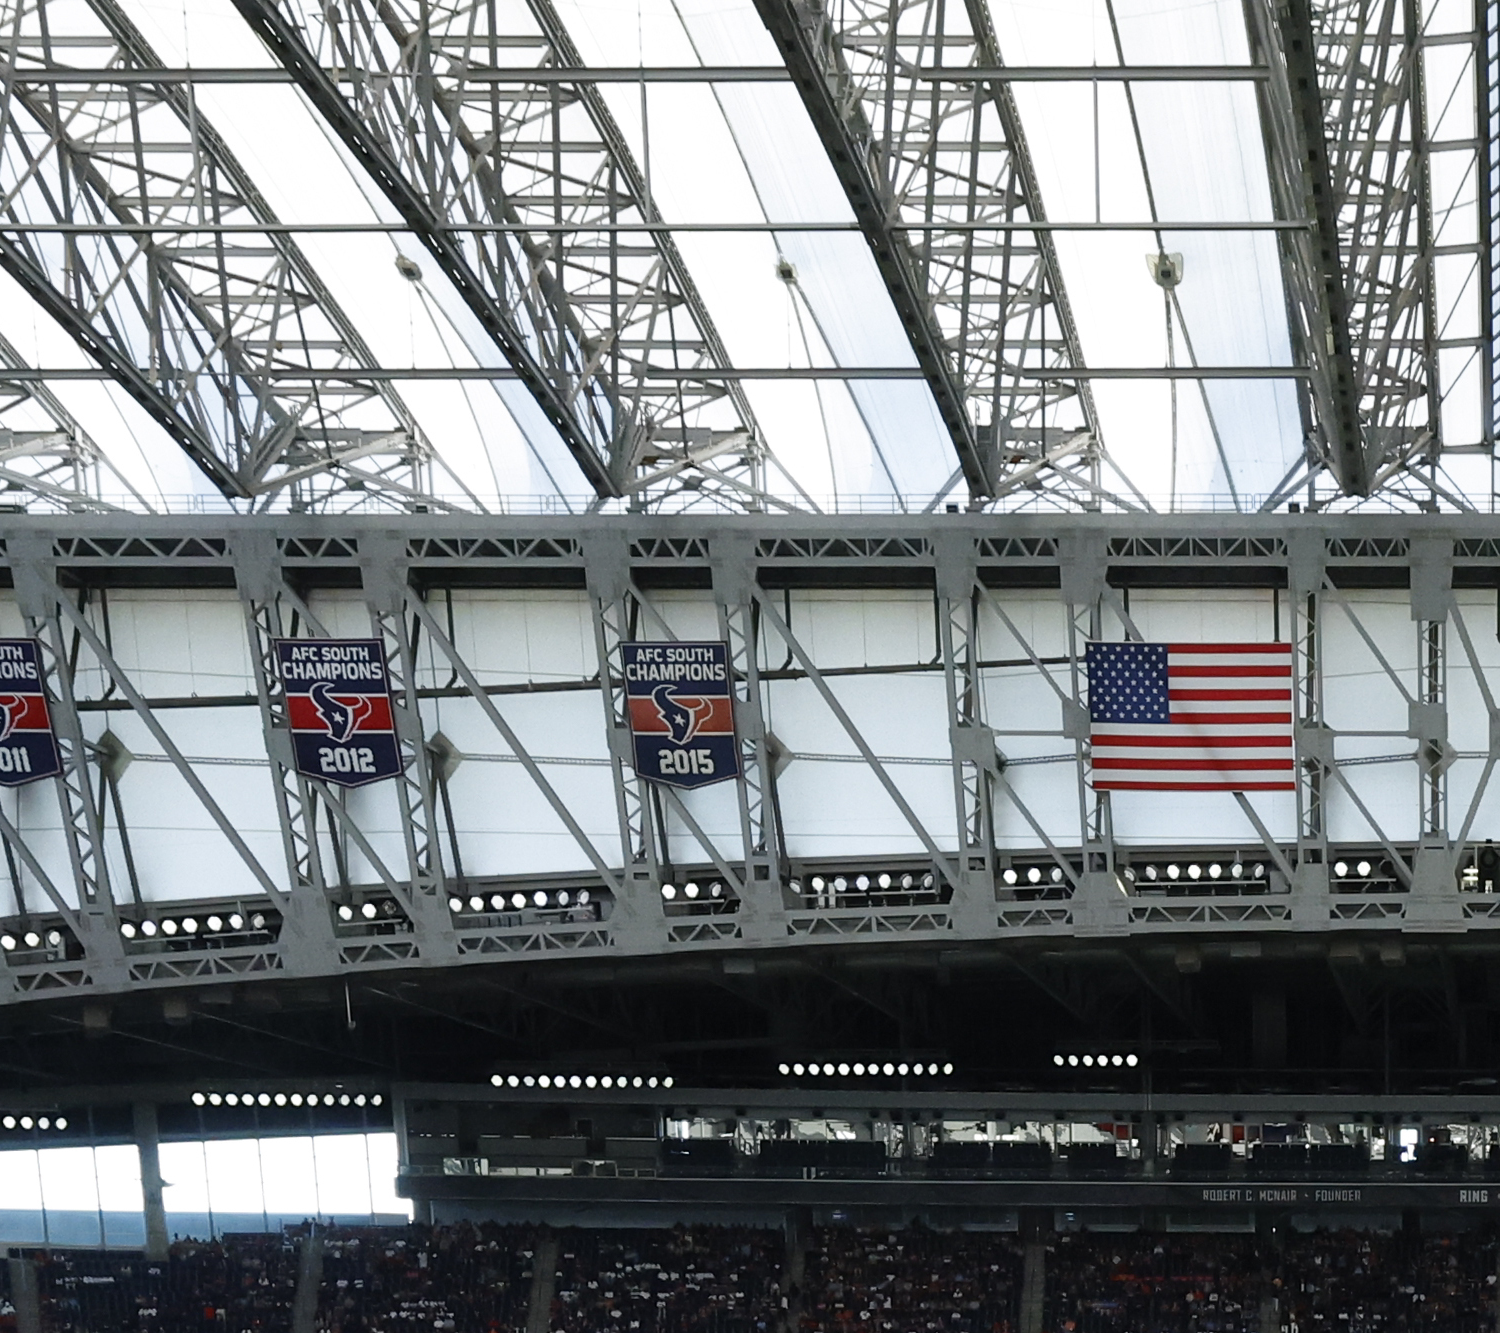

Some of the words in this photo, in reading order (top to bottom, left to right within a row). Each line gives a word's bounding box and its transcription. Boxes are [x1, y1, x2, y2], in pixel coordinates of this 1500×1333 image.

[291, 644, 319, 662] AFC
[320, 644, 370, 662] SOUTH
[635, 647, 664, 664] AFC
[666, 647, 715, 664] SOUTH
[282, 660, 384, 682] CHAMPIONS
[625, 662, 728, 683] CHAMPIONS
[318, 745, 378, 775] 2012
[659, 748, 716, 777] 2015
